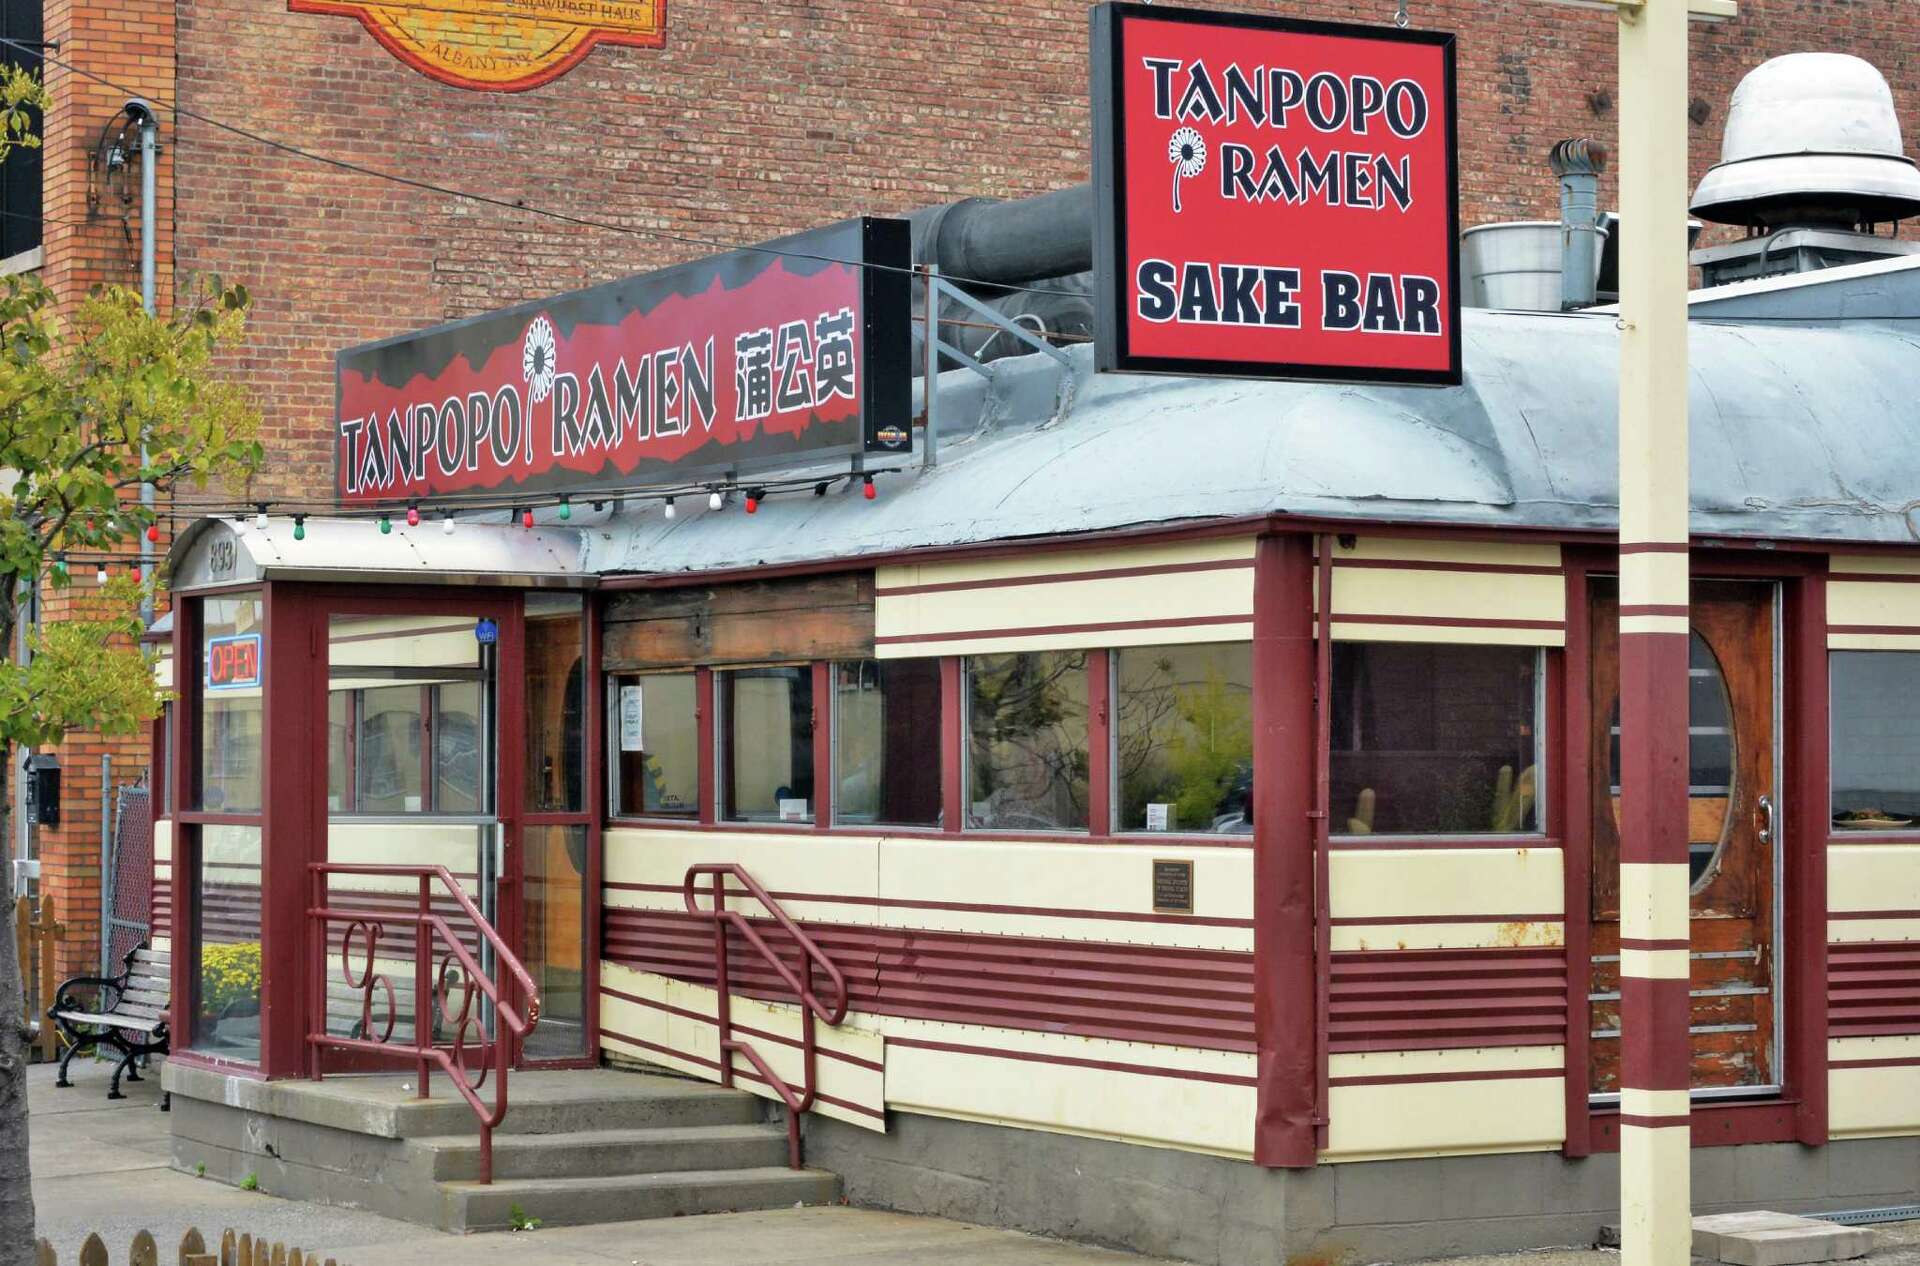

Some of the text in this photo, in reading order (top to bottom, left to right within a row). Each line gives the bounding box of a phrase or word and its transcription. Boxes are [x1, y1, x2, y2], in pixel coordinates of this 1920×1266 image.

[601, 5, 641, 21] HAUS
[431, 43, 496, 70] ALBANY
[1142, 57, 1428, 138] TANPOPO
[1220, 143, 1413, 212] RAMEN
[1137, 259, 1442, 336] SAKE BAR
[735, 307, 855, 422] 蒲公英
[340, 335, 716, 494] TANPOPO RAMEN
[211, 643, 257, 682] OPEN
